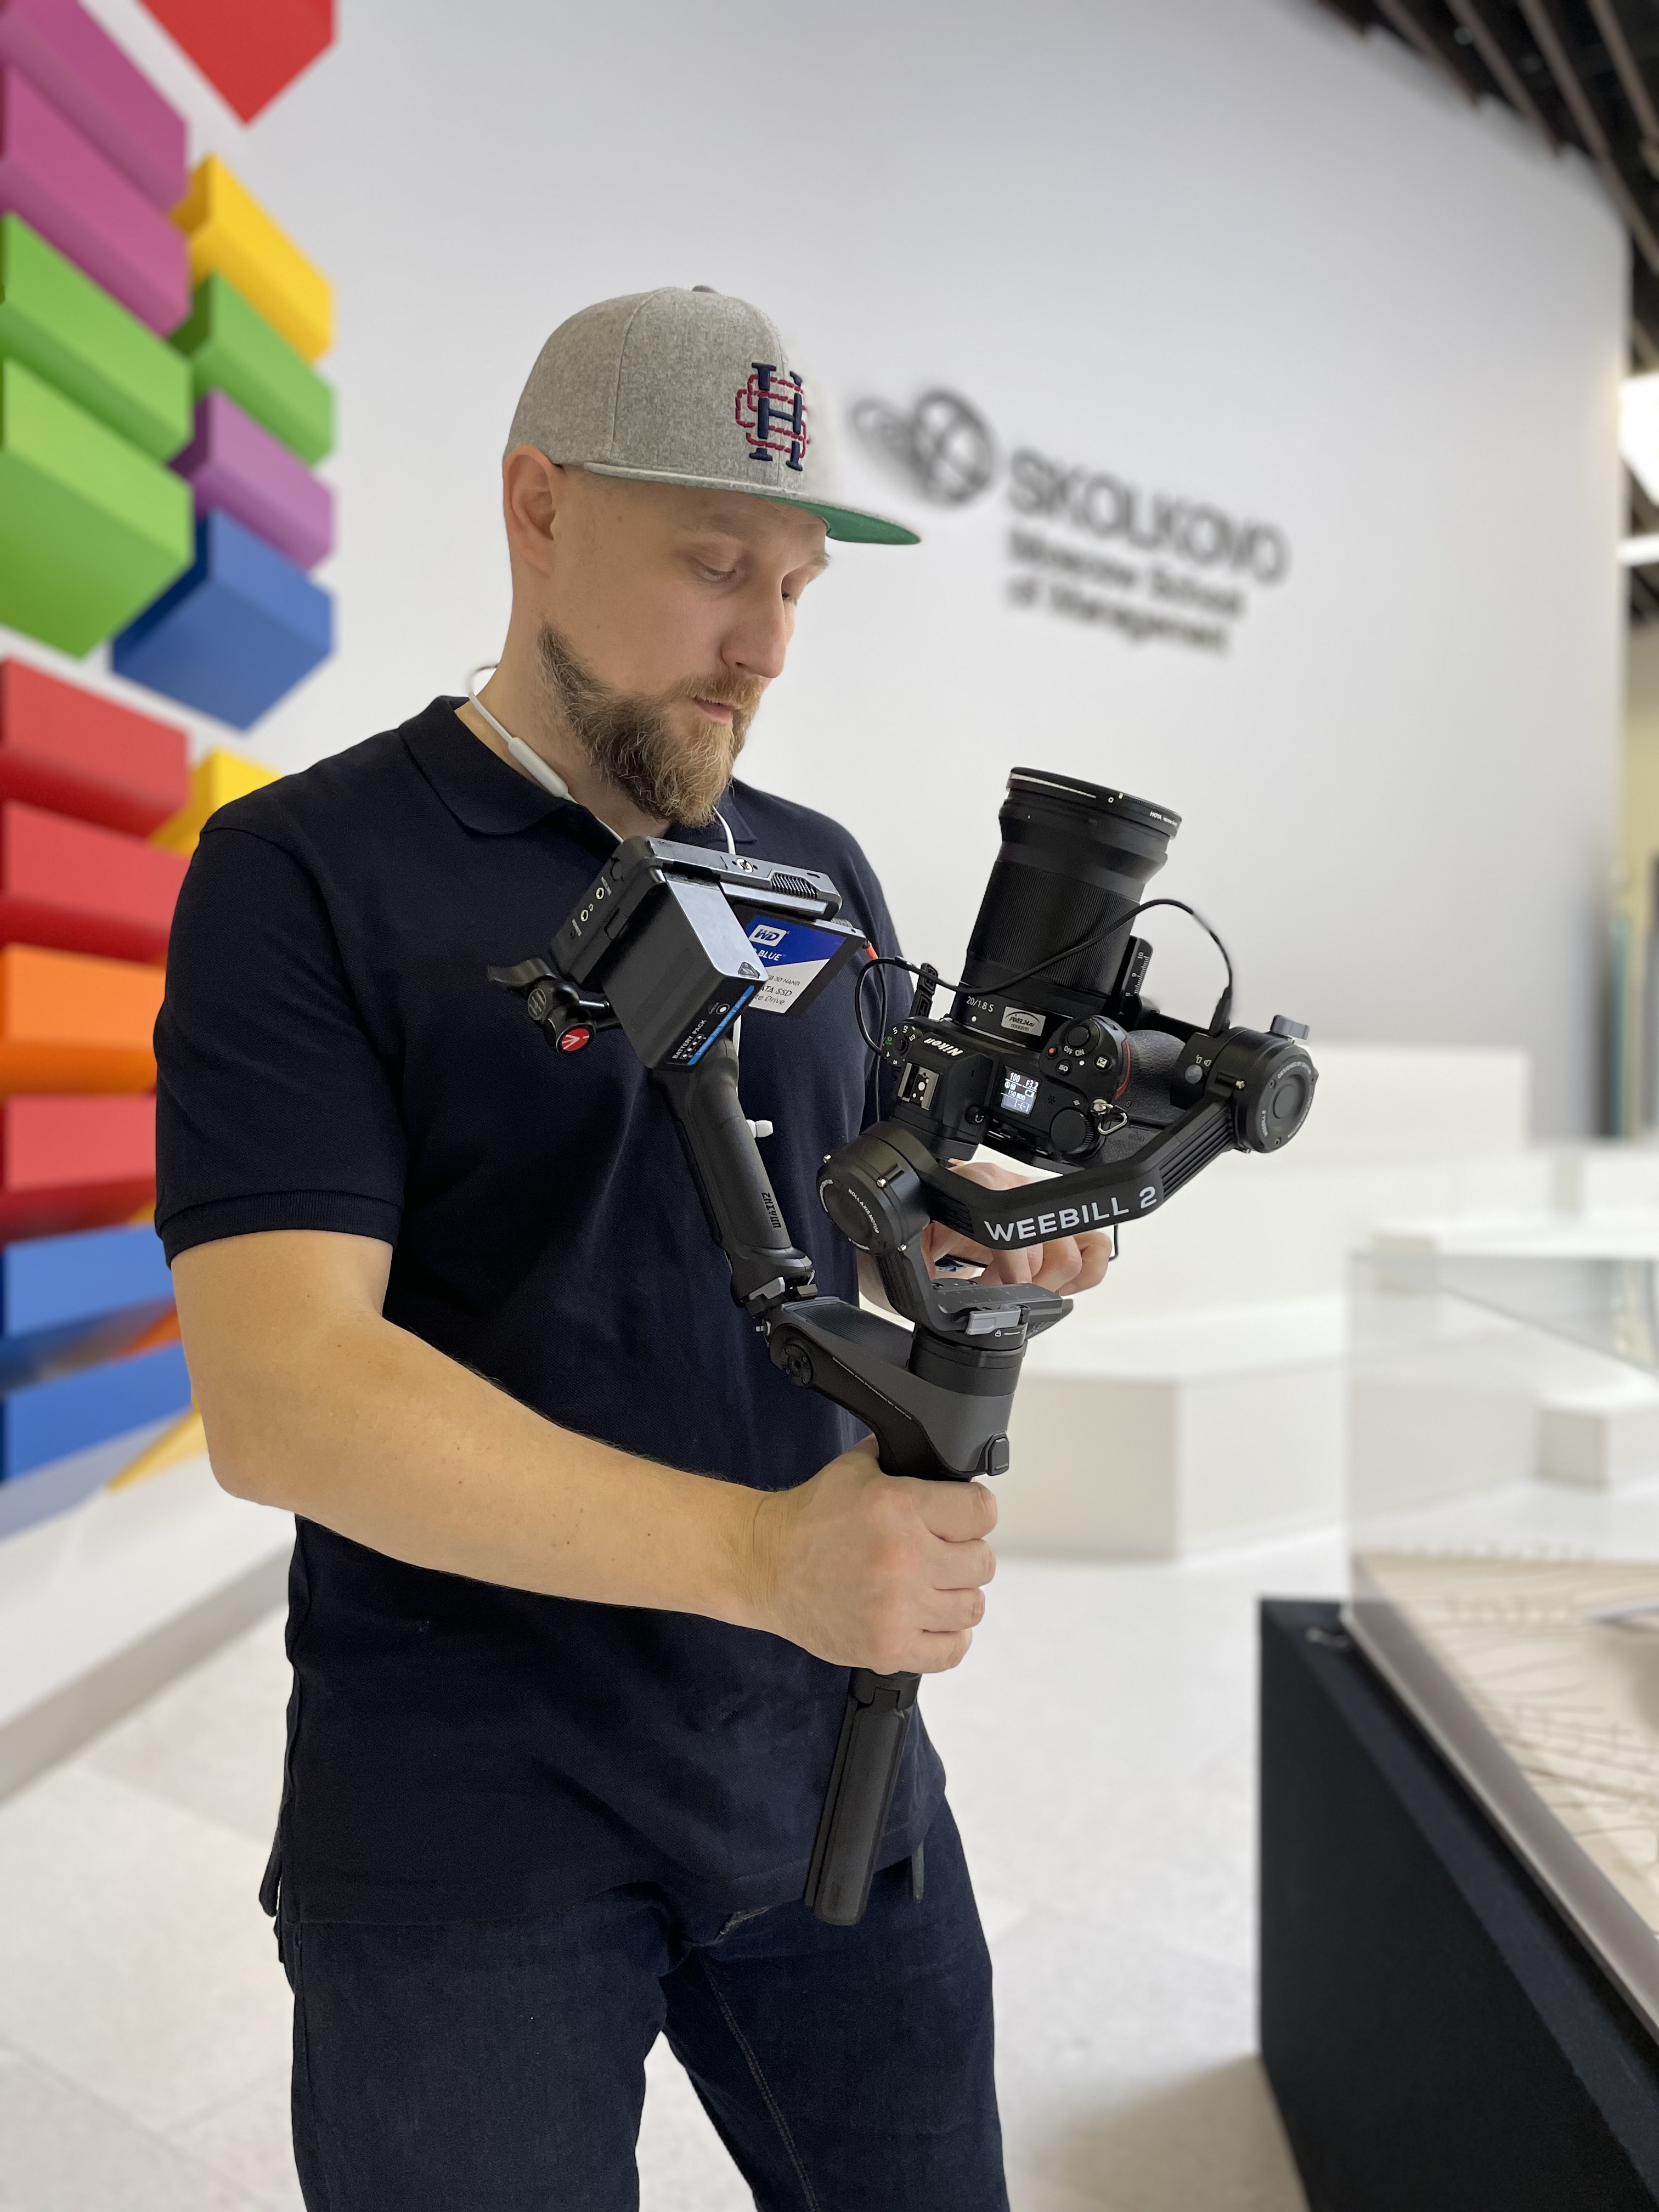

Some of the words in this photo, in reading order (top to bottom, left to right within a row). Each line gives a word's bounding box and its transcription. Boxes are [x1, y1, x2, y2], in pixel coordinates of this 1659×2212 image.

[1150, 811, 1162, 820] HOYA
[753, 928, 780, 941] WD
[758, 950, 782, 961] BLUE
[775, 988, 793, 997] SSD
[765, 995, 785, 1005] Drive
[966, 996, 988, 1010] 20/1.8
[988, 1004, 994, 1012] S
[672, 1036, 693, 1059] BATTERY
[692, 1019, 707, 1034] PACK
[923, 1038, 964, 1057] Nikon
[1064, 1045, 1073, 1055] OFF
[1058, 1064, 1069, 1072] ISO
[1009, 1071, 1021, 1083] 100
[1025, 1079, 1039, 1090] F3.2
[1007, 1089, 1016, 1098] ISO
[984, 1197, 1130, 1242] WEEBILL
[1139, 1186, 1157, 1209] 2
